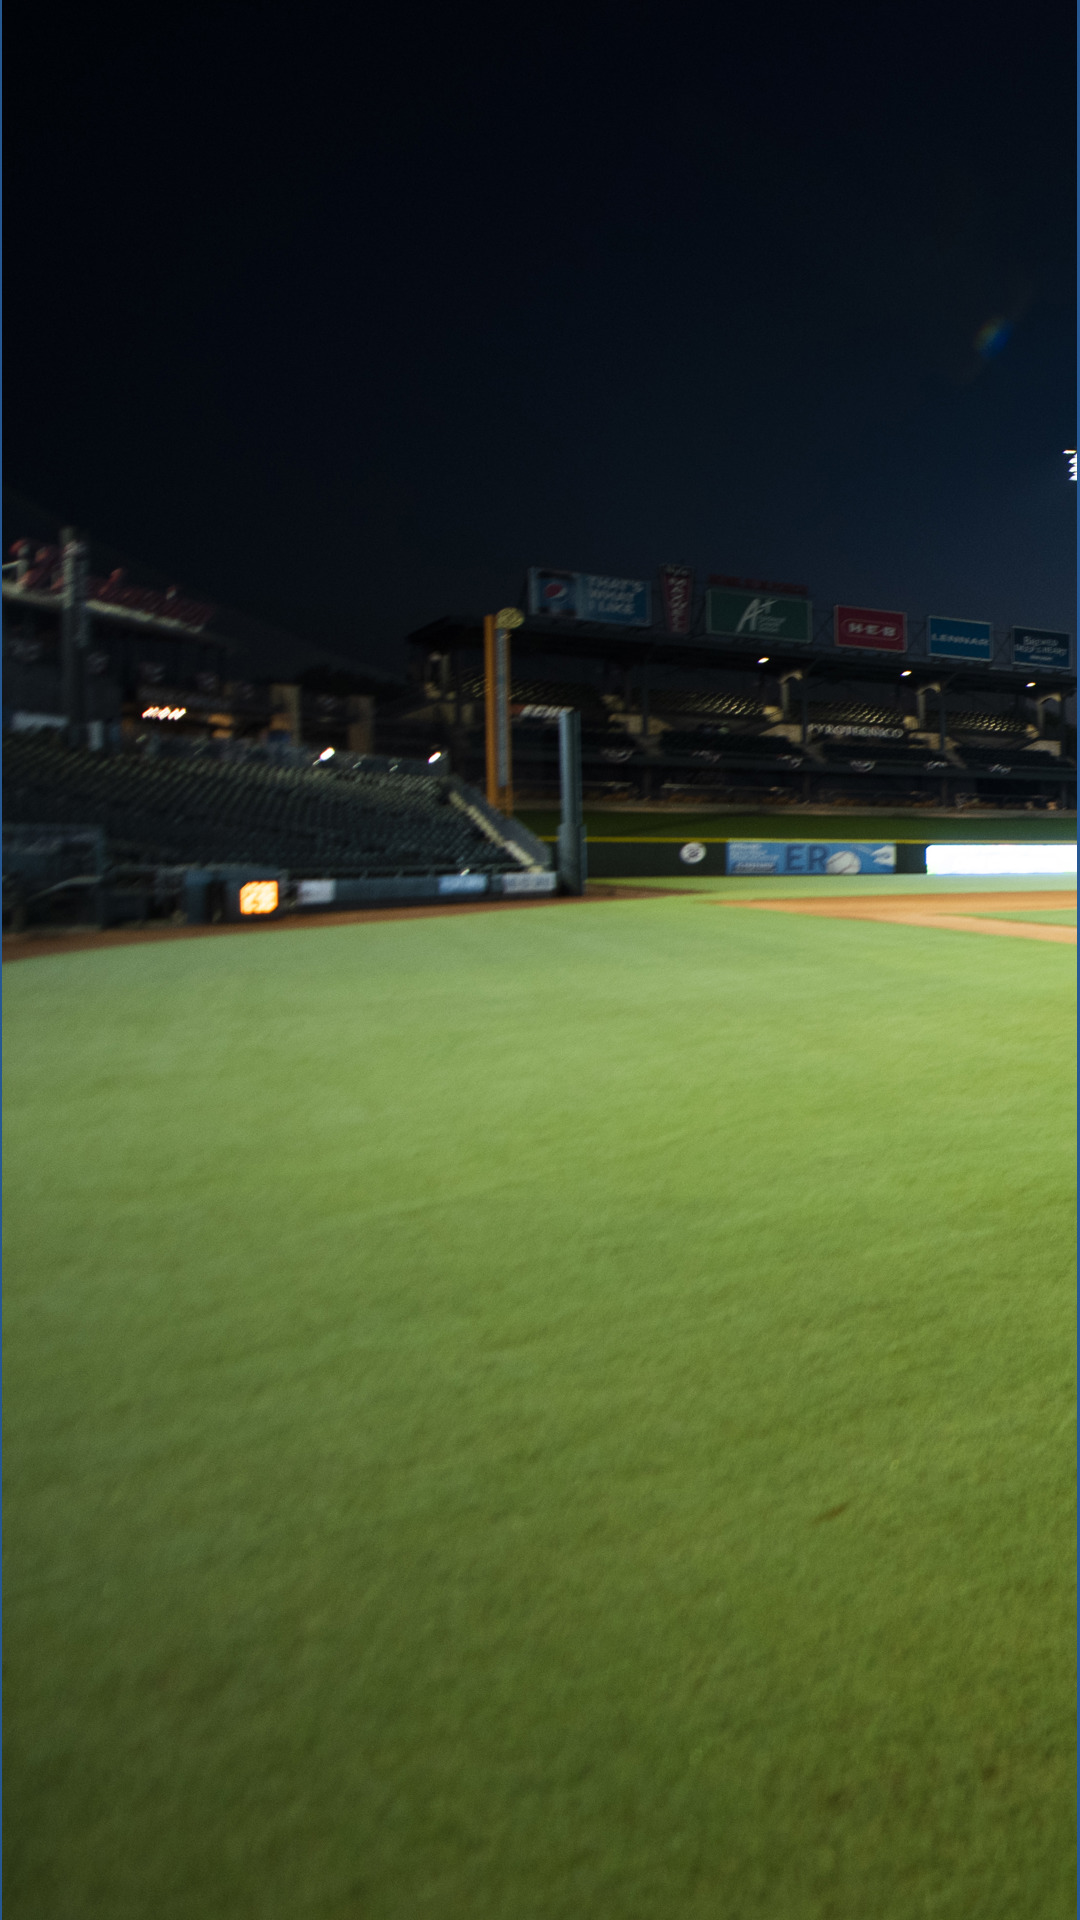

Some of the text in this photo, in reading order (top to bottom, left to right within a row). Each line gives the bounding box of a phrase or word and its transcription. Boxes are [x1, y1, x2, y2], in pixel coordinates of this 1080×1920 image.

[931, 633, 991, 647] LENNAR
[807, 723, 904, 739] PYROTECNICO
[784, 843, 828, 872] ER
